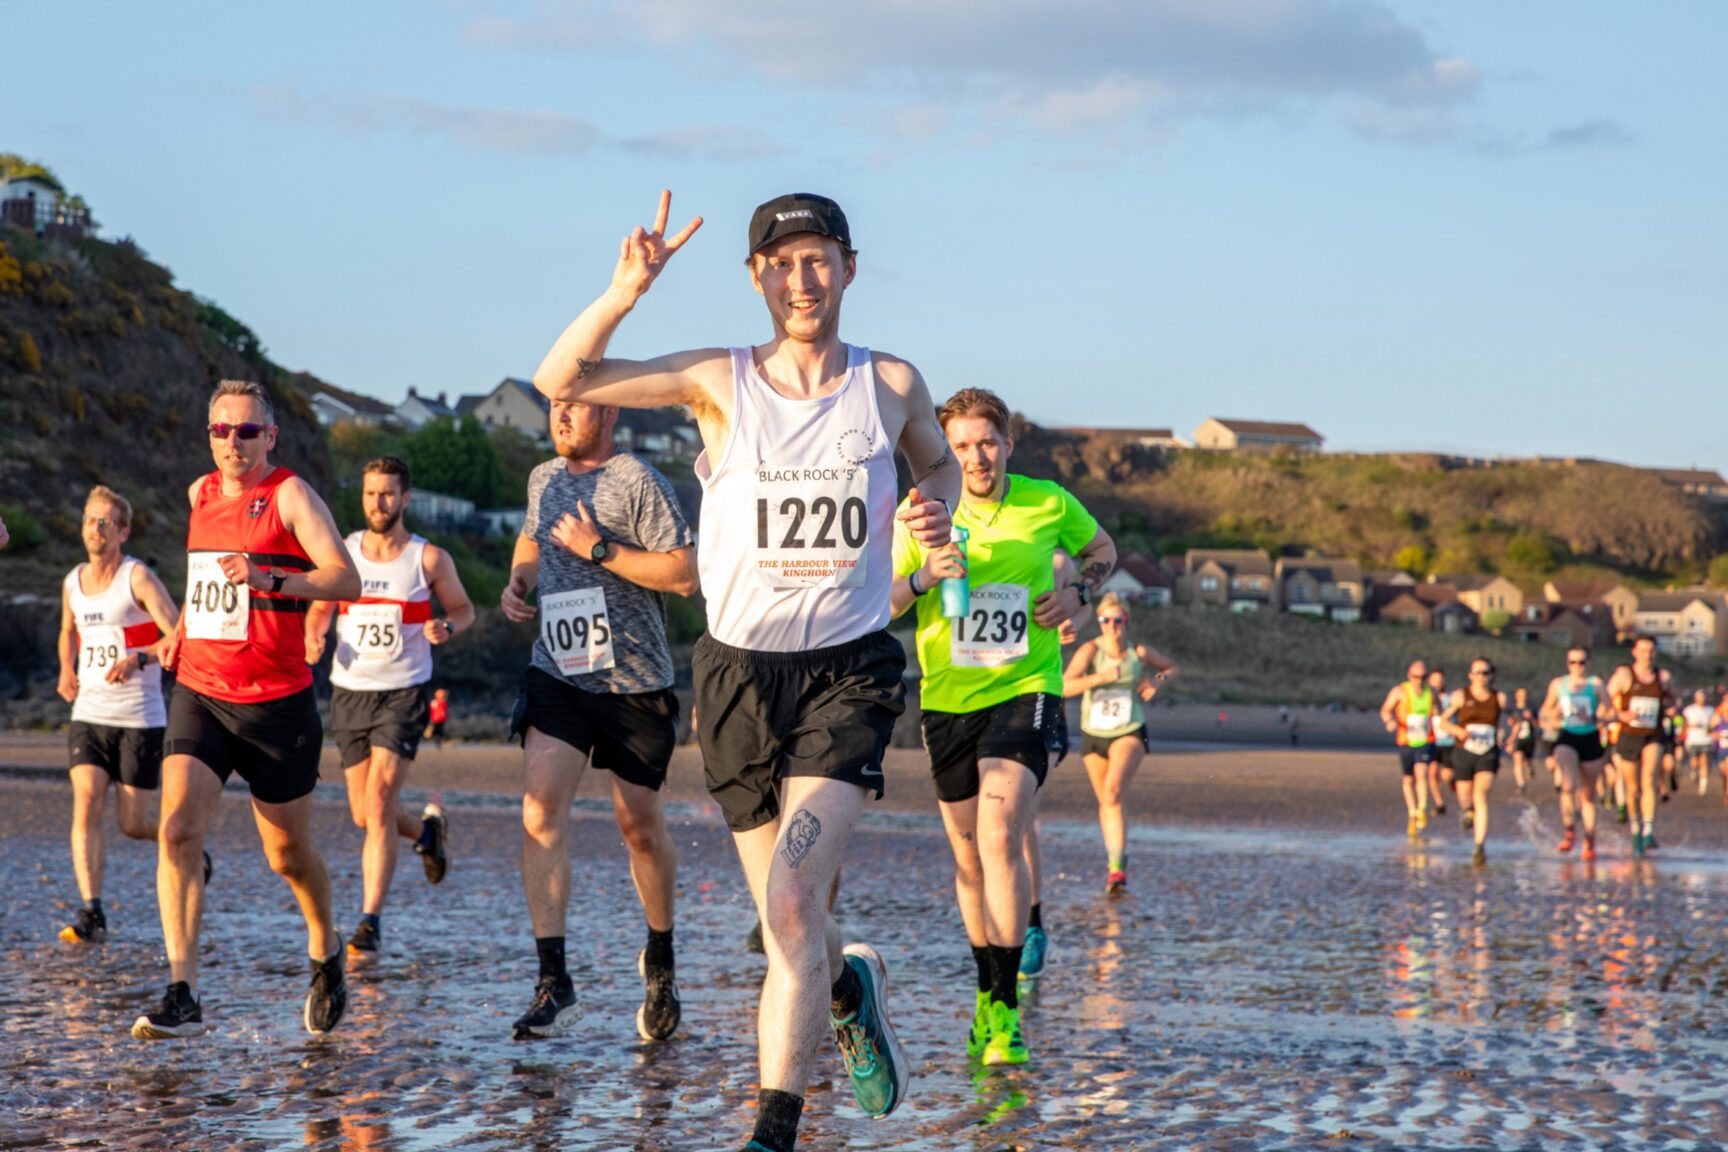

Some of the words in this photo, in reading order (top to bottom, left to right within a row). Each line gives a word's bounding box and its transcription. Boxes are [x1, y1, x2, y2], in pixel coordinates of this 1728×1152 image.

[759, 470, 800, 482] BLACK
[803, 468, 839, 481] ROCK
[757, 496, 868, 549] 1220
[758, 560, 779, 568] THE
[781, 560, 829, 568] HARBOUR
[832, 559, 857, 568] VIEW
[782, 569, 836, 577] KINGHORN
[364, 579, 389, 591] FIFE
[191, 580, 238, 614] 400
[565, 597, 585, 607] ROCK
[988, 591, 1011, 600] ROCK
[84, 611, 105, 622] FIFE
[547, 613, 609, 652] 1095
[958, 608, 1028, 644] 1239
[357, 624, 395, 647] 735
[86, 644, 118, 669] 739
